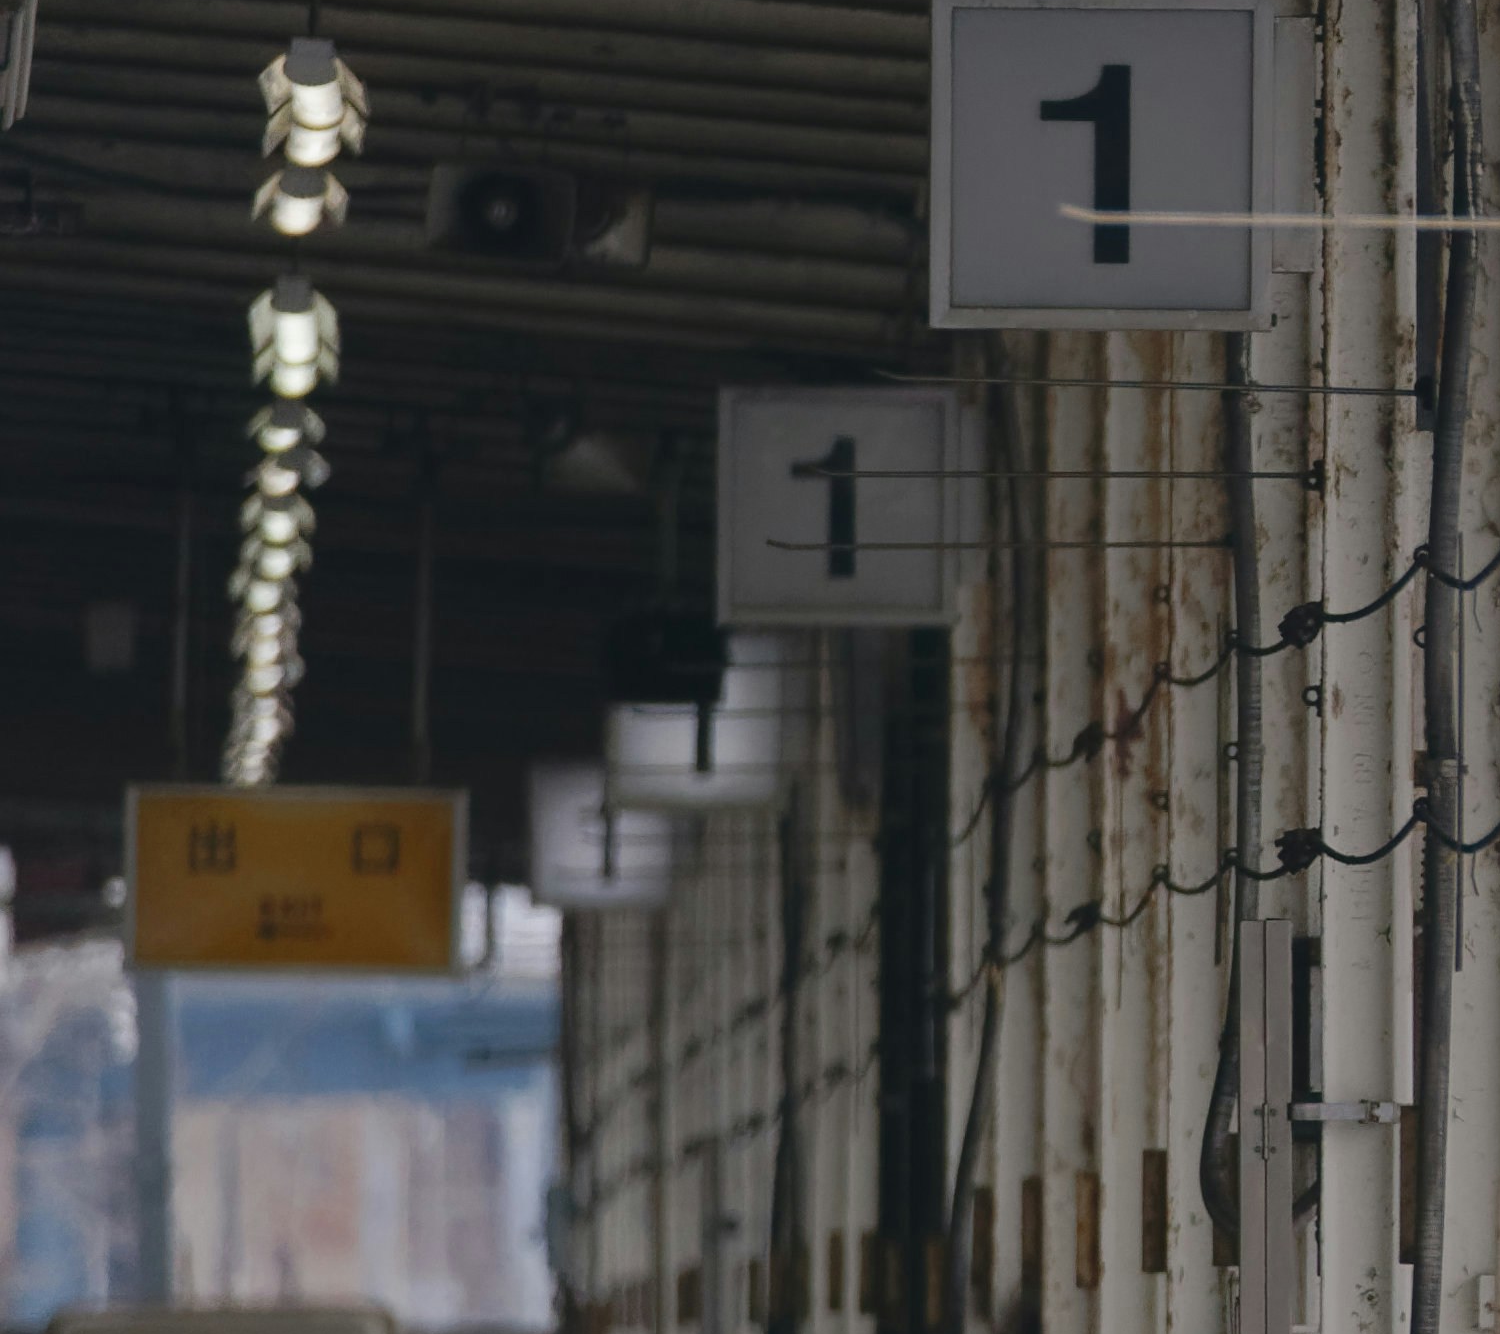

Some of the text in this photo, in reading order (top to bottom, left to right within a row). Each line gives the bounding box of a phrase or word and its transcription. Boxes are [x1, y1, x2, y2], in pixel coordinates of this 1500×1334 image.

[1040, 64, 1131, 264] 1
[791, 434, 855, 578] 1
[189, 821, 399, 875] 出口
